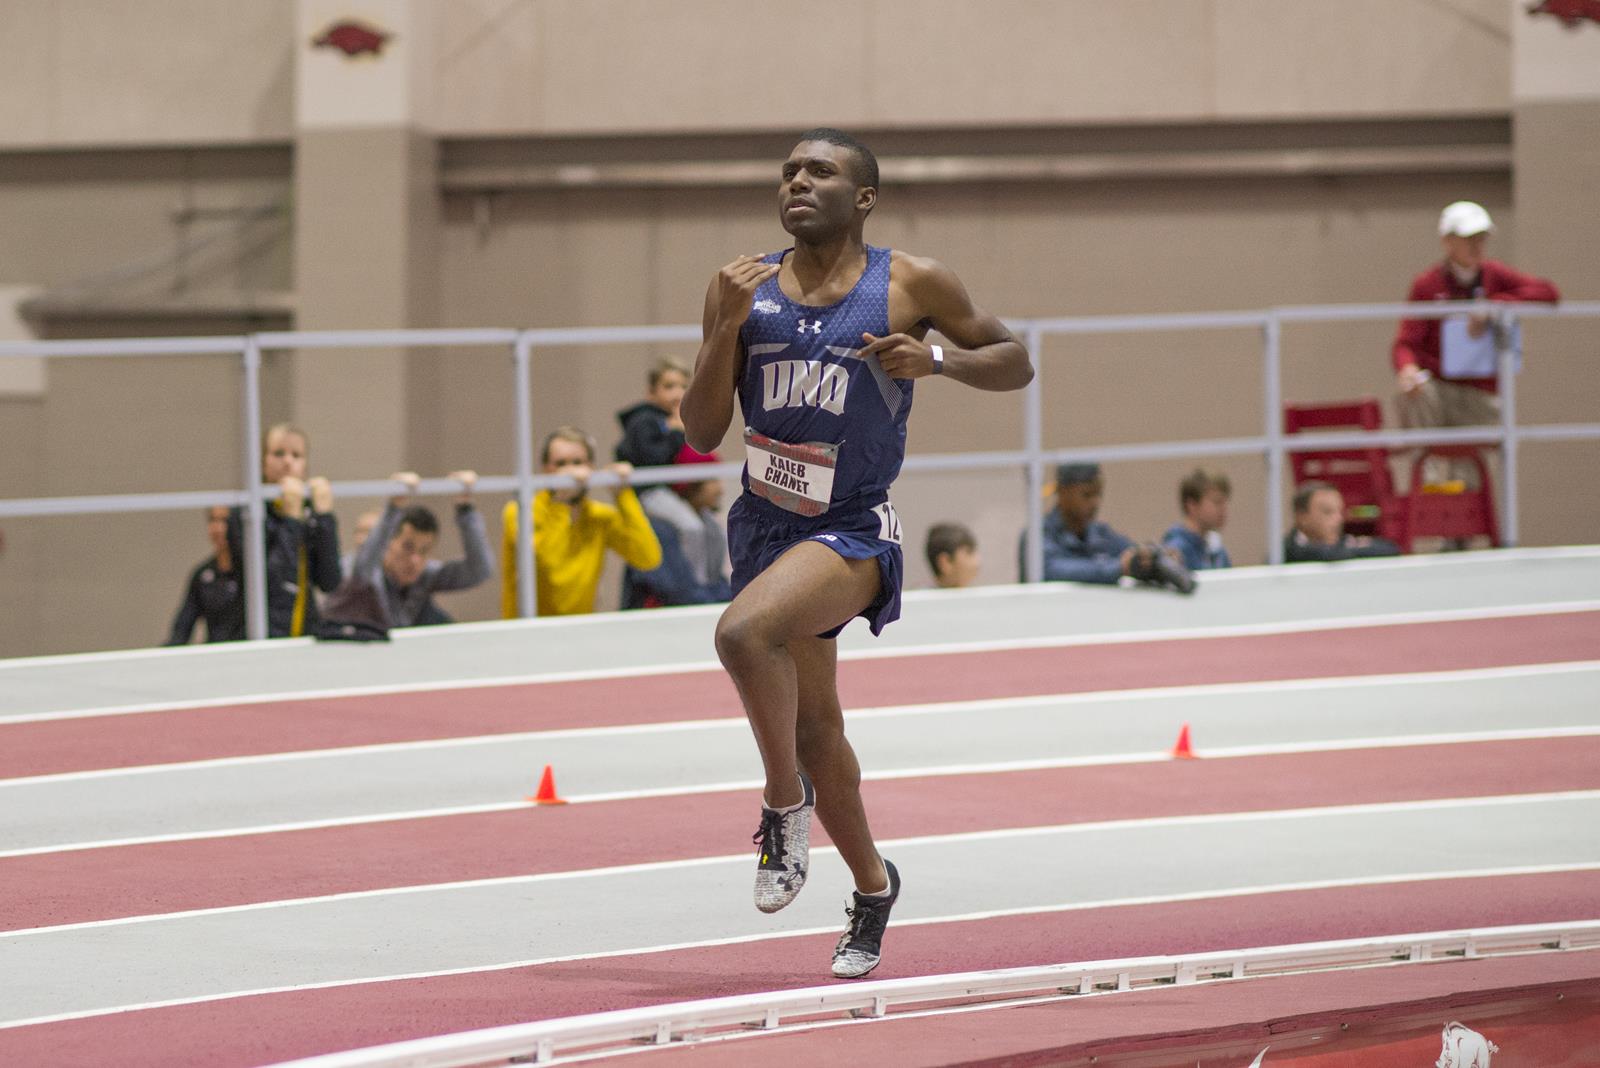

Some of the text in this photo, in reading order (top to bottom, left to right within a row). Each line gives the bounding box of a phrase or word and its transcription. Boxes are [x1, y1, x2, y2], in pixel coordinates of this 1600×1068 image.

[761, 360, 849, 416] UNO
[770, 454, 806, 478] KALEB
[764, 467, 810, 494] CHANET
